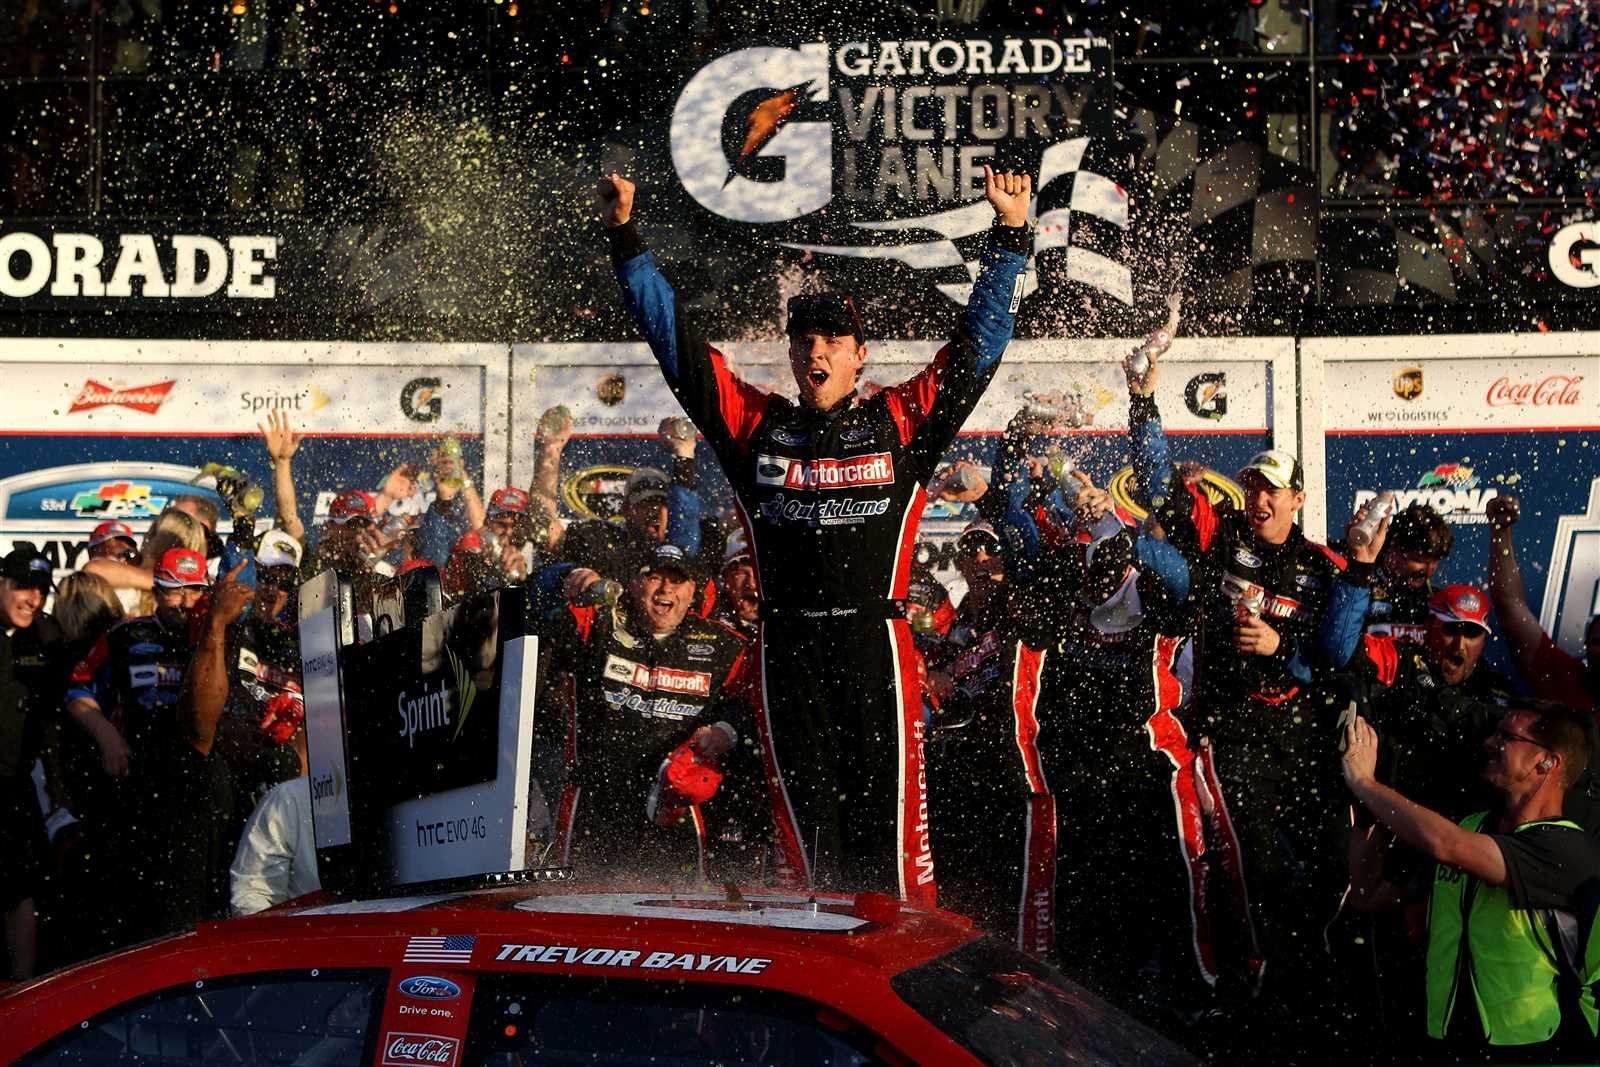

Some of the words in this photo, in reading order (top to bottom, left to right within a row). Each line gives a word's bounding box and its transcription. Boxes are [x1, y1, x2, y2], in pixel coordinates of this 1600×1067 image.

[839, 84, 1092, 141] VICTORY
[843, 144, 997, 202] LANE
[0, 231, 277, 299] ORADE
[1548, 220, 1600, 289] G
[241, 391, 302, 413] Sprint
[1486, 374, 1581, 407] Coca-Cola
[598, 416, 648, 427] LOGISTICS
[1368, 410, 1385, 423] WE
[1395, 410, 1449, 423] LOGISTICS
[790, 455, 890, 487] Motorcraft
[40, 498, 68, 512] 53rd
[783, 499, 842, 521] Quick
[838, 496, 891, 517] Lane
[1353, 487, 1498, 515] DYTONA
[636, 667, 706, 692] Motorcraft
[397, 678, 451, 749] Sprint
[312, 773, 335, 806] Sprint
[416, 819, 445, 847] htc
[470, 816, 486, 840] 4G
[495, 943, 641, 968] TREVOR
[640, 949, 773, 975] BAYNE
[407, 978, 454, 997] Ford
[399, 1004, 428, 1015] Drive
[430, 1007, 454, 1019] one.
[387, 1036, 455, 1063] Coca-Cola
